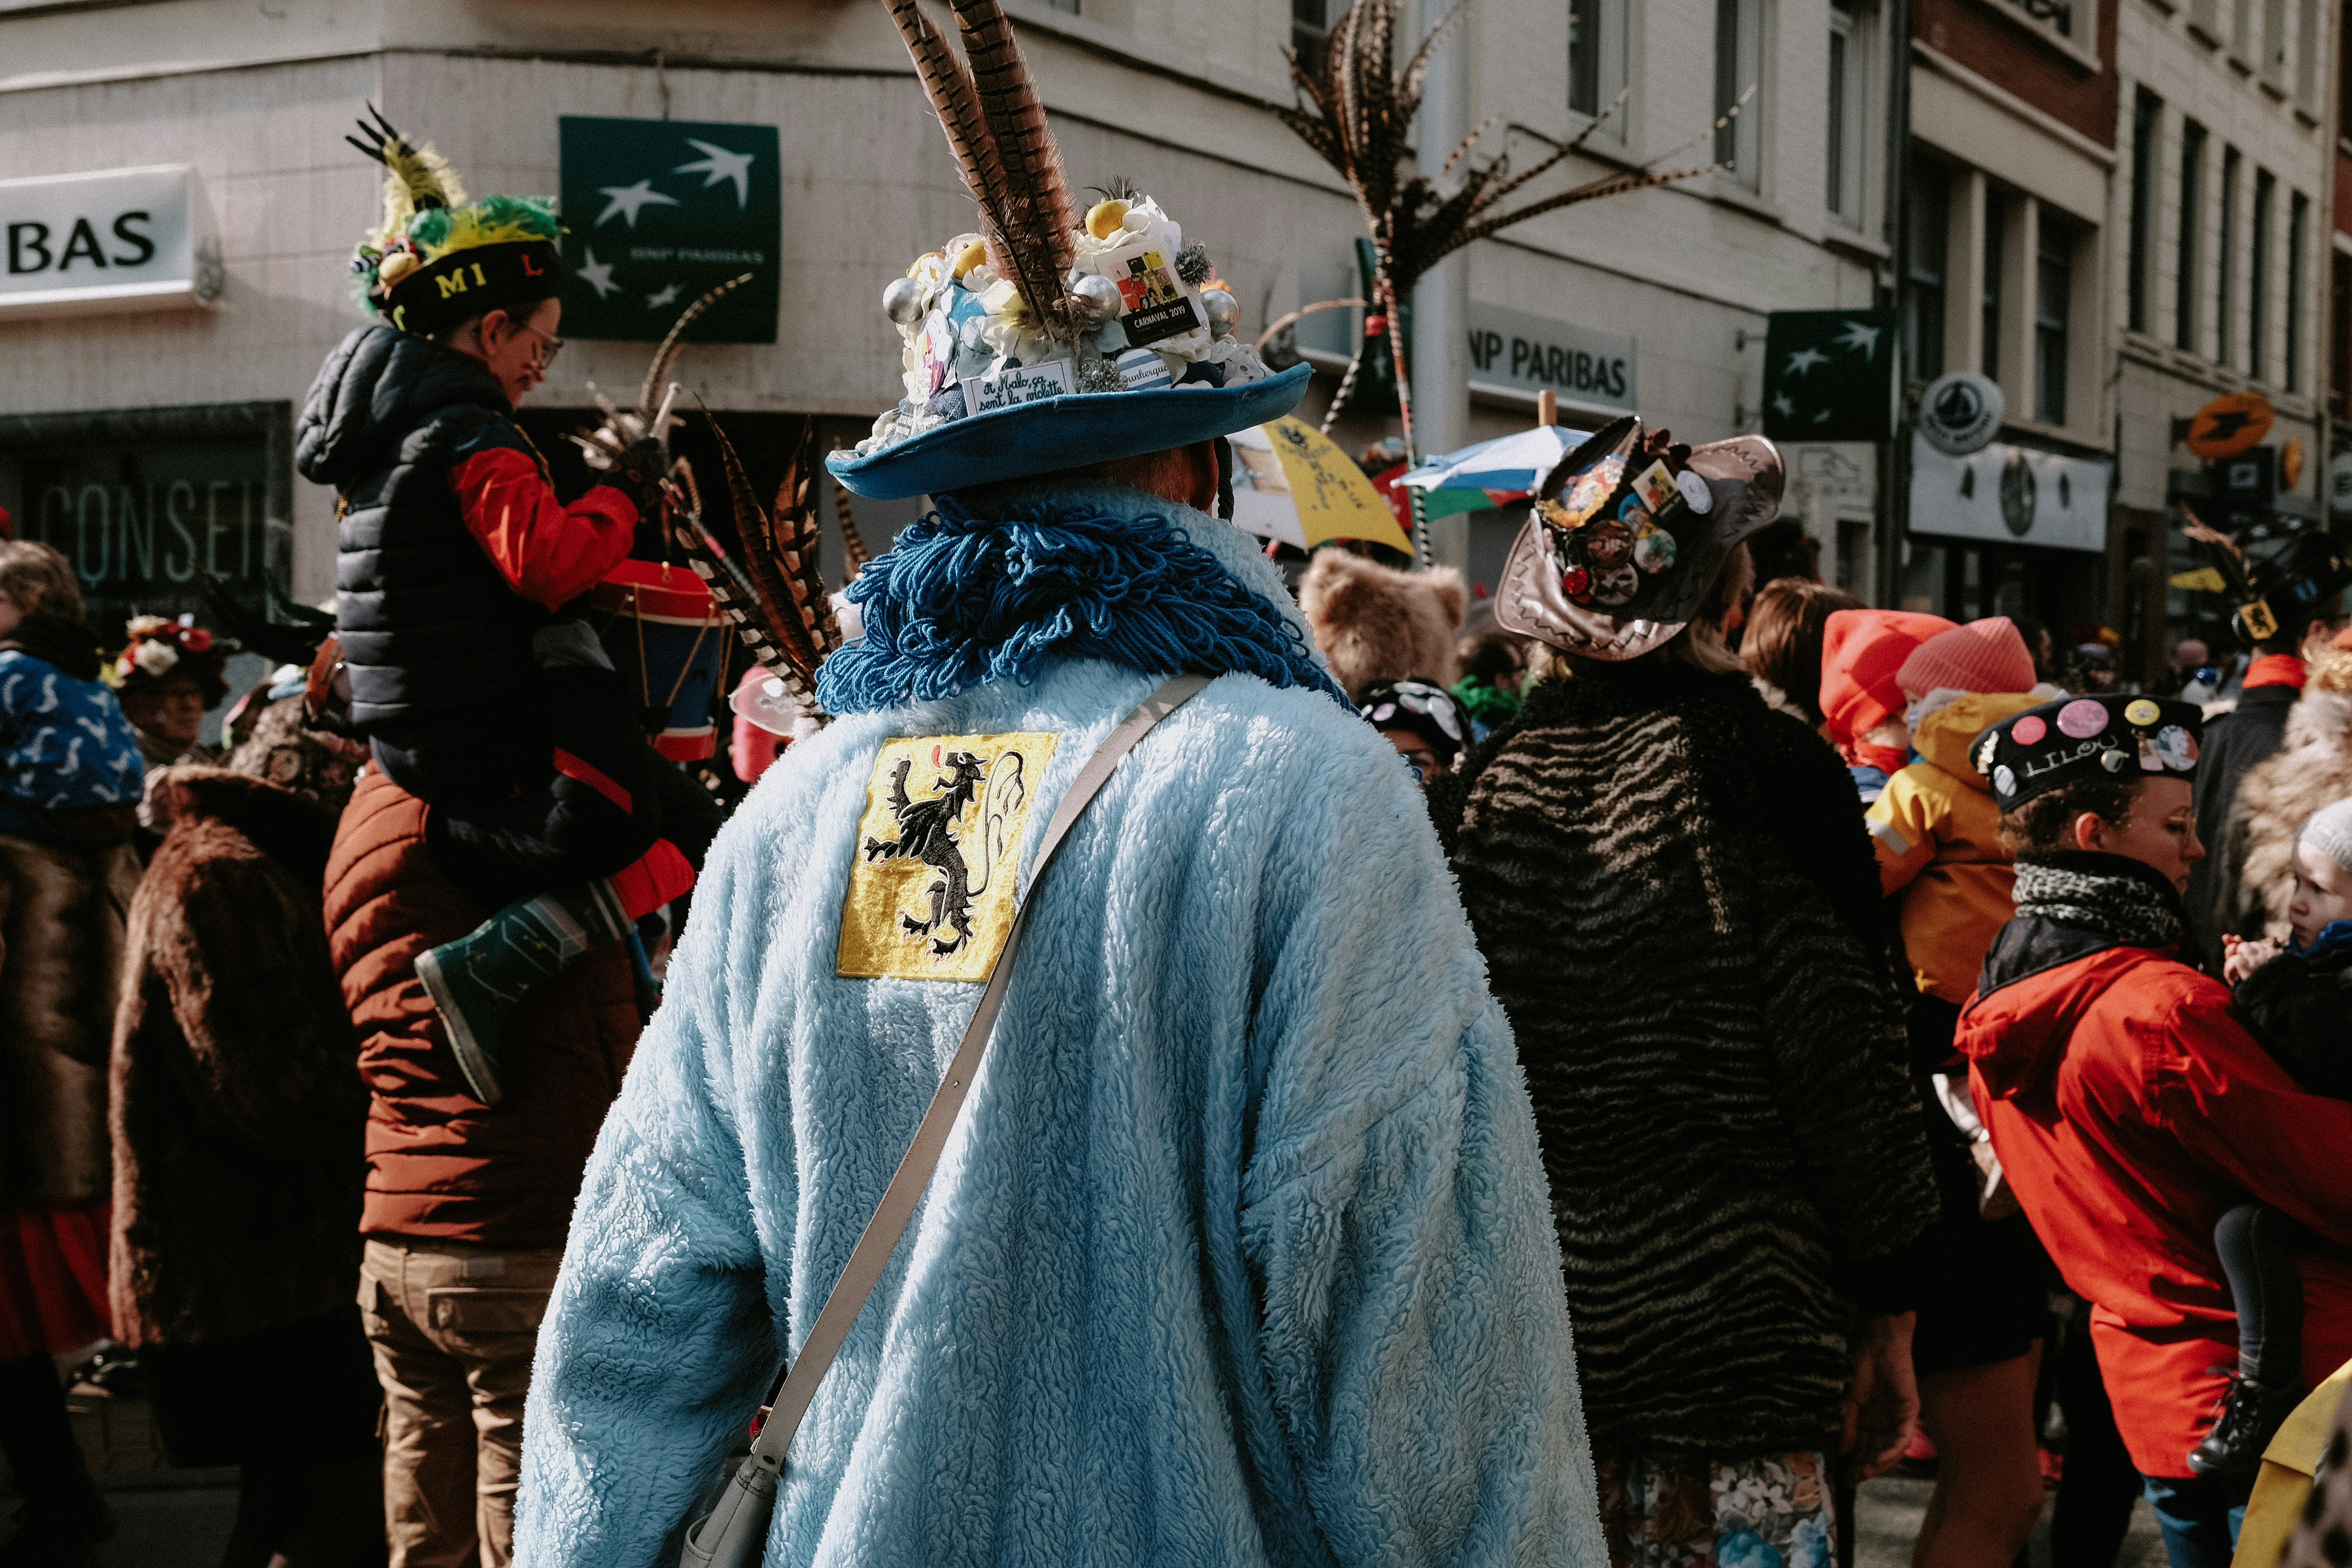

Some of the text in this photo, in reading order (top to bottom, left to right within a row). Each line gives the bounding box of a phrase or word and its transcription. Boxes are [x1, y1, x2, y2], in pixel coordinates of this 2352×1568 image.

[8, 212, 155, 274] BAS
[1134, 305, 1185, 328] CARNAVAL 2019
[1127, 365, 1169, 383] unkerque
[1468, 327, 1626, 397] NP PARIBAS
[979, 380, 1065, 411] sent la violette
[998, 372, 1031, 392] Malo,
[1032, 375, 1047, 388] ça
